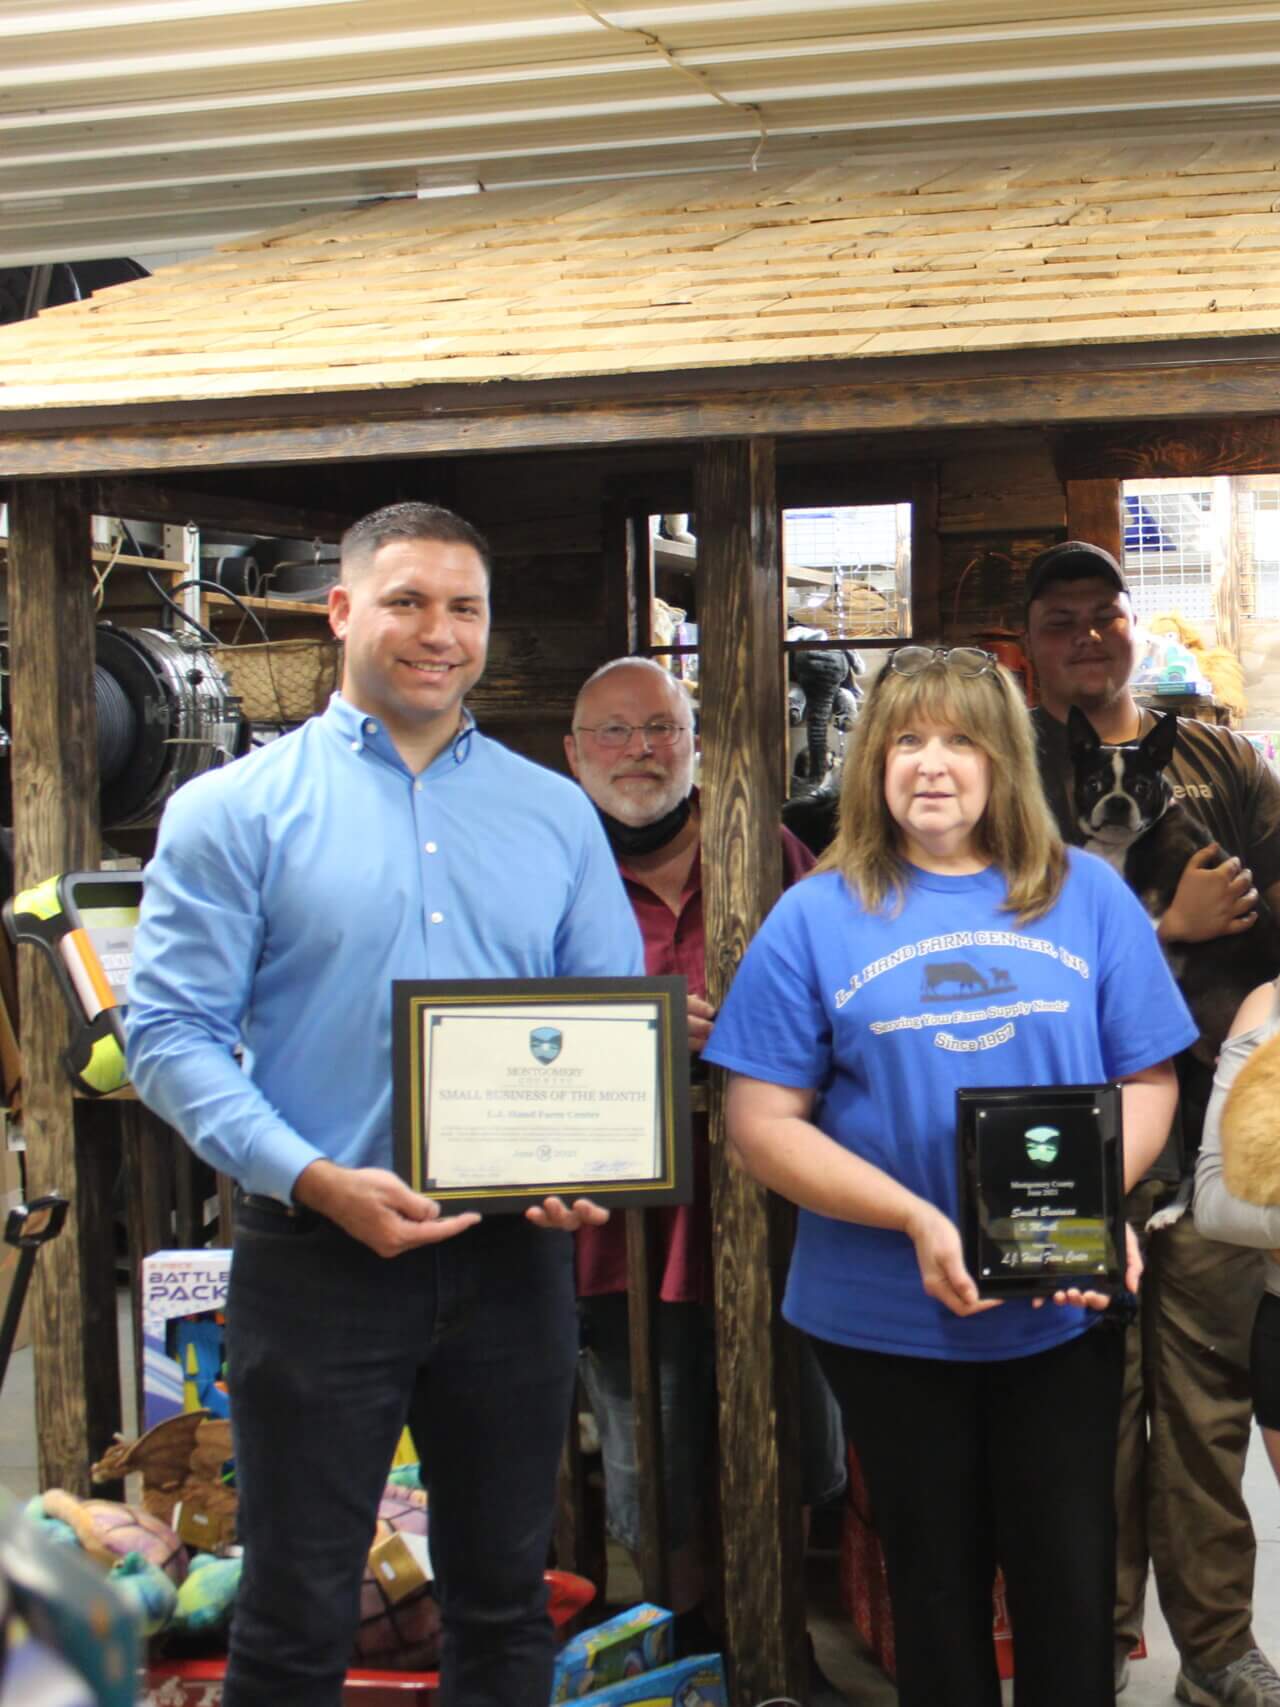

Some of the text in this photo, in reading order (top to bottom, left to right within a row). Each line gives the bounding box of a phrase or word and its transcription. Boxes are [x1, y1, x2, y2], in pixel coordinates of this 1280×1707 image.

[1173, 784, 1213, 799] ena
[862, 945, 916, 983] HAND
[917, 932, 972, 956] FARM
[951, 1006, 987, 1023] Farm
[987, 1002, 1031, 1019] Supply
[935, 1022, 1015, 1052] Since 1967
[439, 1090, 647, 1102] SMALL BUSINESS OF THE MONTH
[149, 1272, 230, 1283] BATTLE
[150, 1285, 229, 1301] PACK
